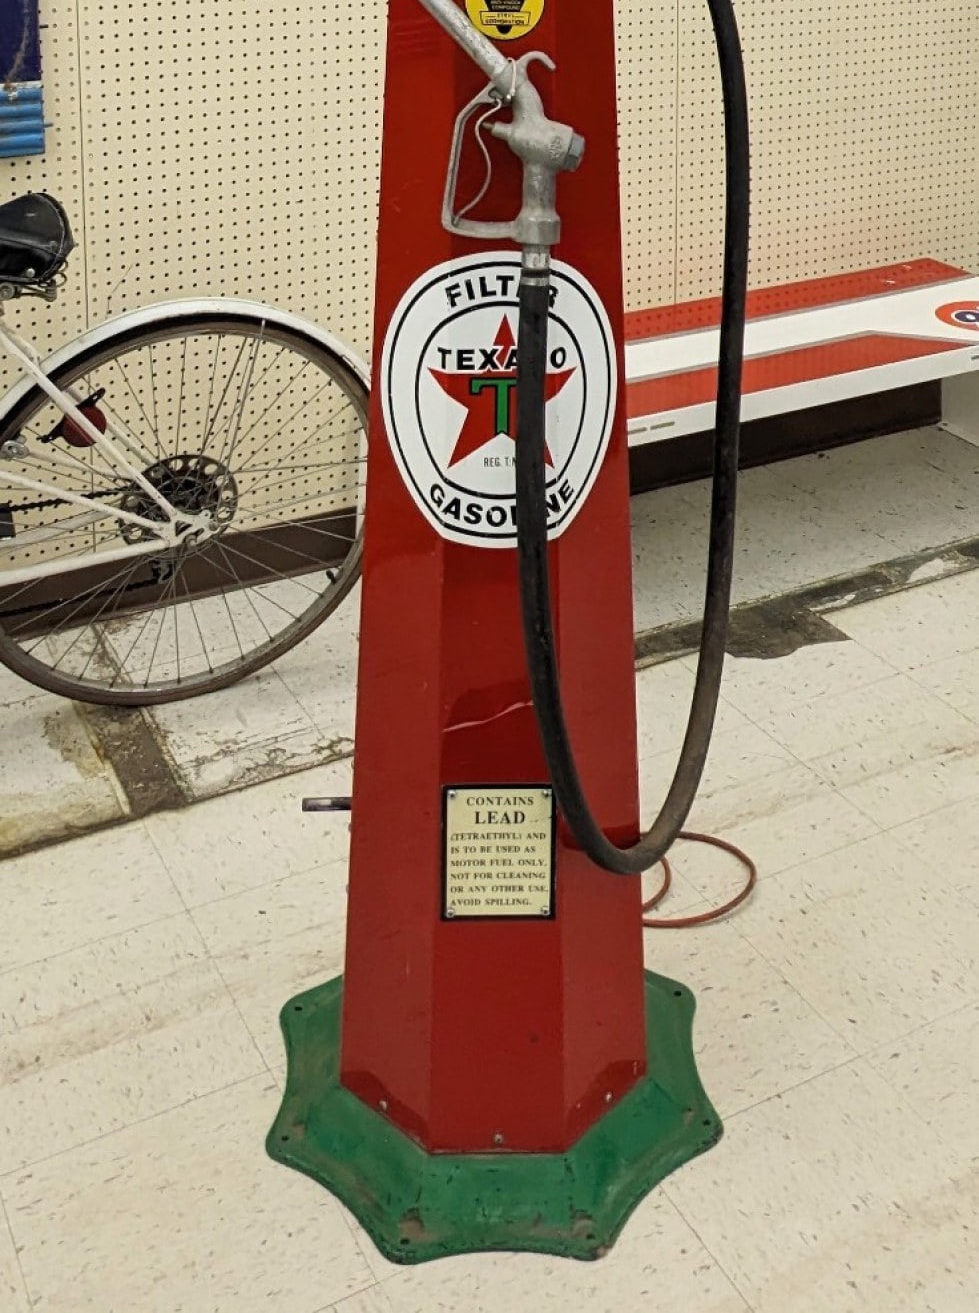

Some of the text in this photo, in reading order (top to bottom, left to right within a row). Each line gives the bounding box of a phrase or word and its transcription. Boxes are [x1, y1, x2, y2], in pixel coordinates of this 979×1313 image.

[444, 275, 560, 308] FILTR
[437, 346, 567, 371] TEXAO
[429, 478, 575, 528] GASONE
[466, 796, 534, 806] CONTAINS
[474, 811, 526, 824] LEAD
[450, 832, 546, 841] (TETRAETHYL) AND
[450, 846, 459, 854] IS
[463, 846, 476, 854] TO
[496, 845, 520, 853] USED
[524, 845, 536, 853] AS
[450, 859, 486, 867] MOTOR
[450, 872, 471, 880] NOT
[474, 872, 492, 880] FOR
[450, 886, 463, 894] OR
[468, 885, 487, 893] ANY
[491, 885, 524, 893] OTHER
[450, 898, 481, 906] AVOID
